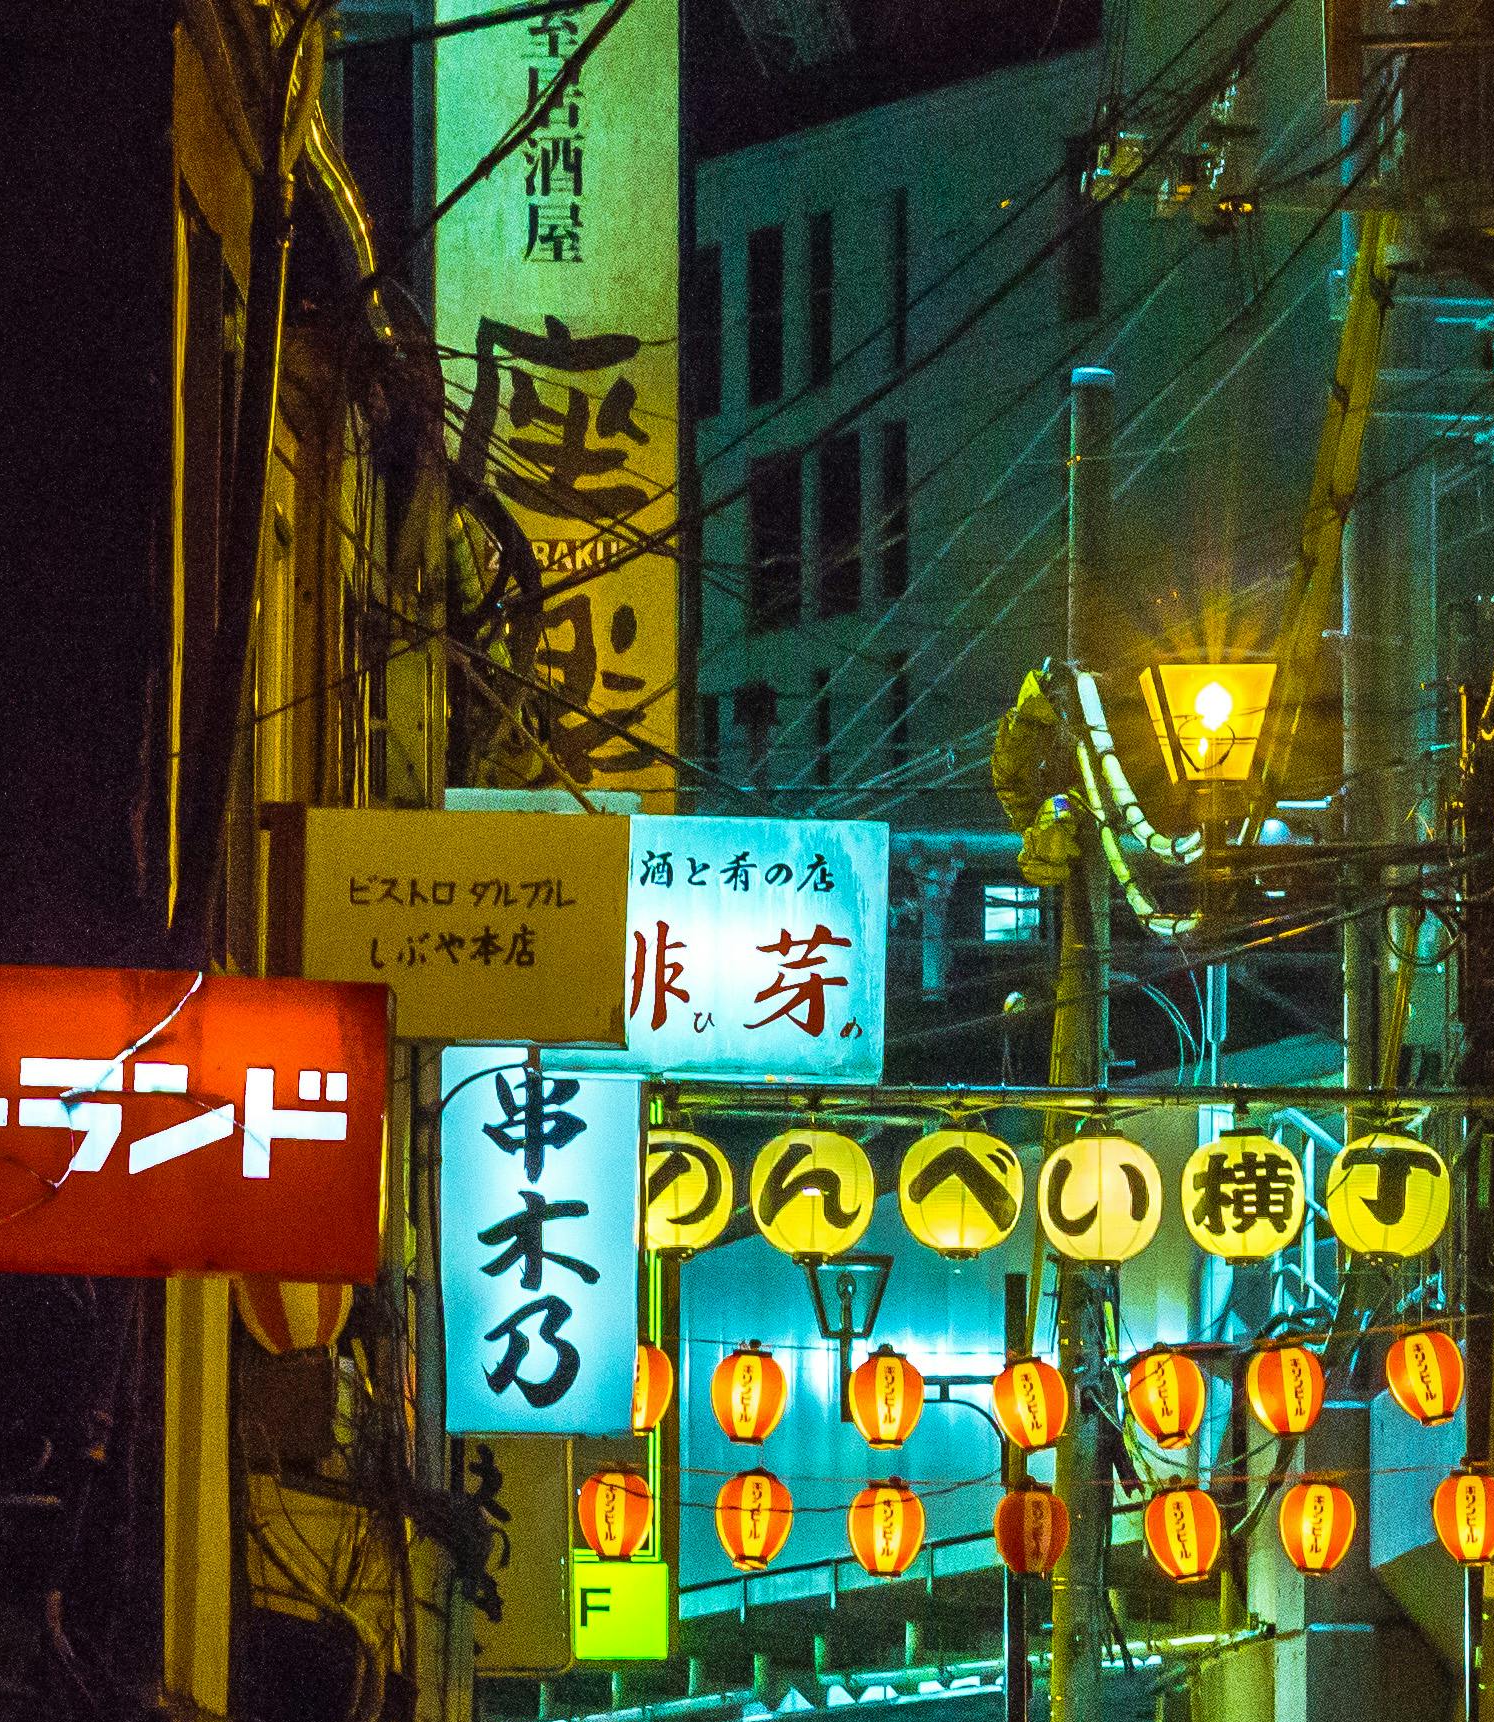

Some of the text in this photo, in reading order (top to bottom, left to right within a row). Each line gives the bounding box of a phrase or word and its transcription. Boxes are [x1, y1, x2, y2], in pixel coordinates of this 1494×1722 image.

[349, 875, 456, 907] ビストロ
[639, 849, 836, 893] 酒と肴の店
[370, 922, 536, 970] しぶや本店
[476, 1068, 602, 1409] 串木乃
[580, 1587, 613, 1629] F
